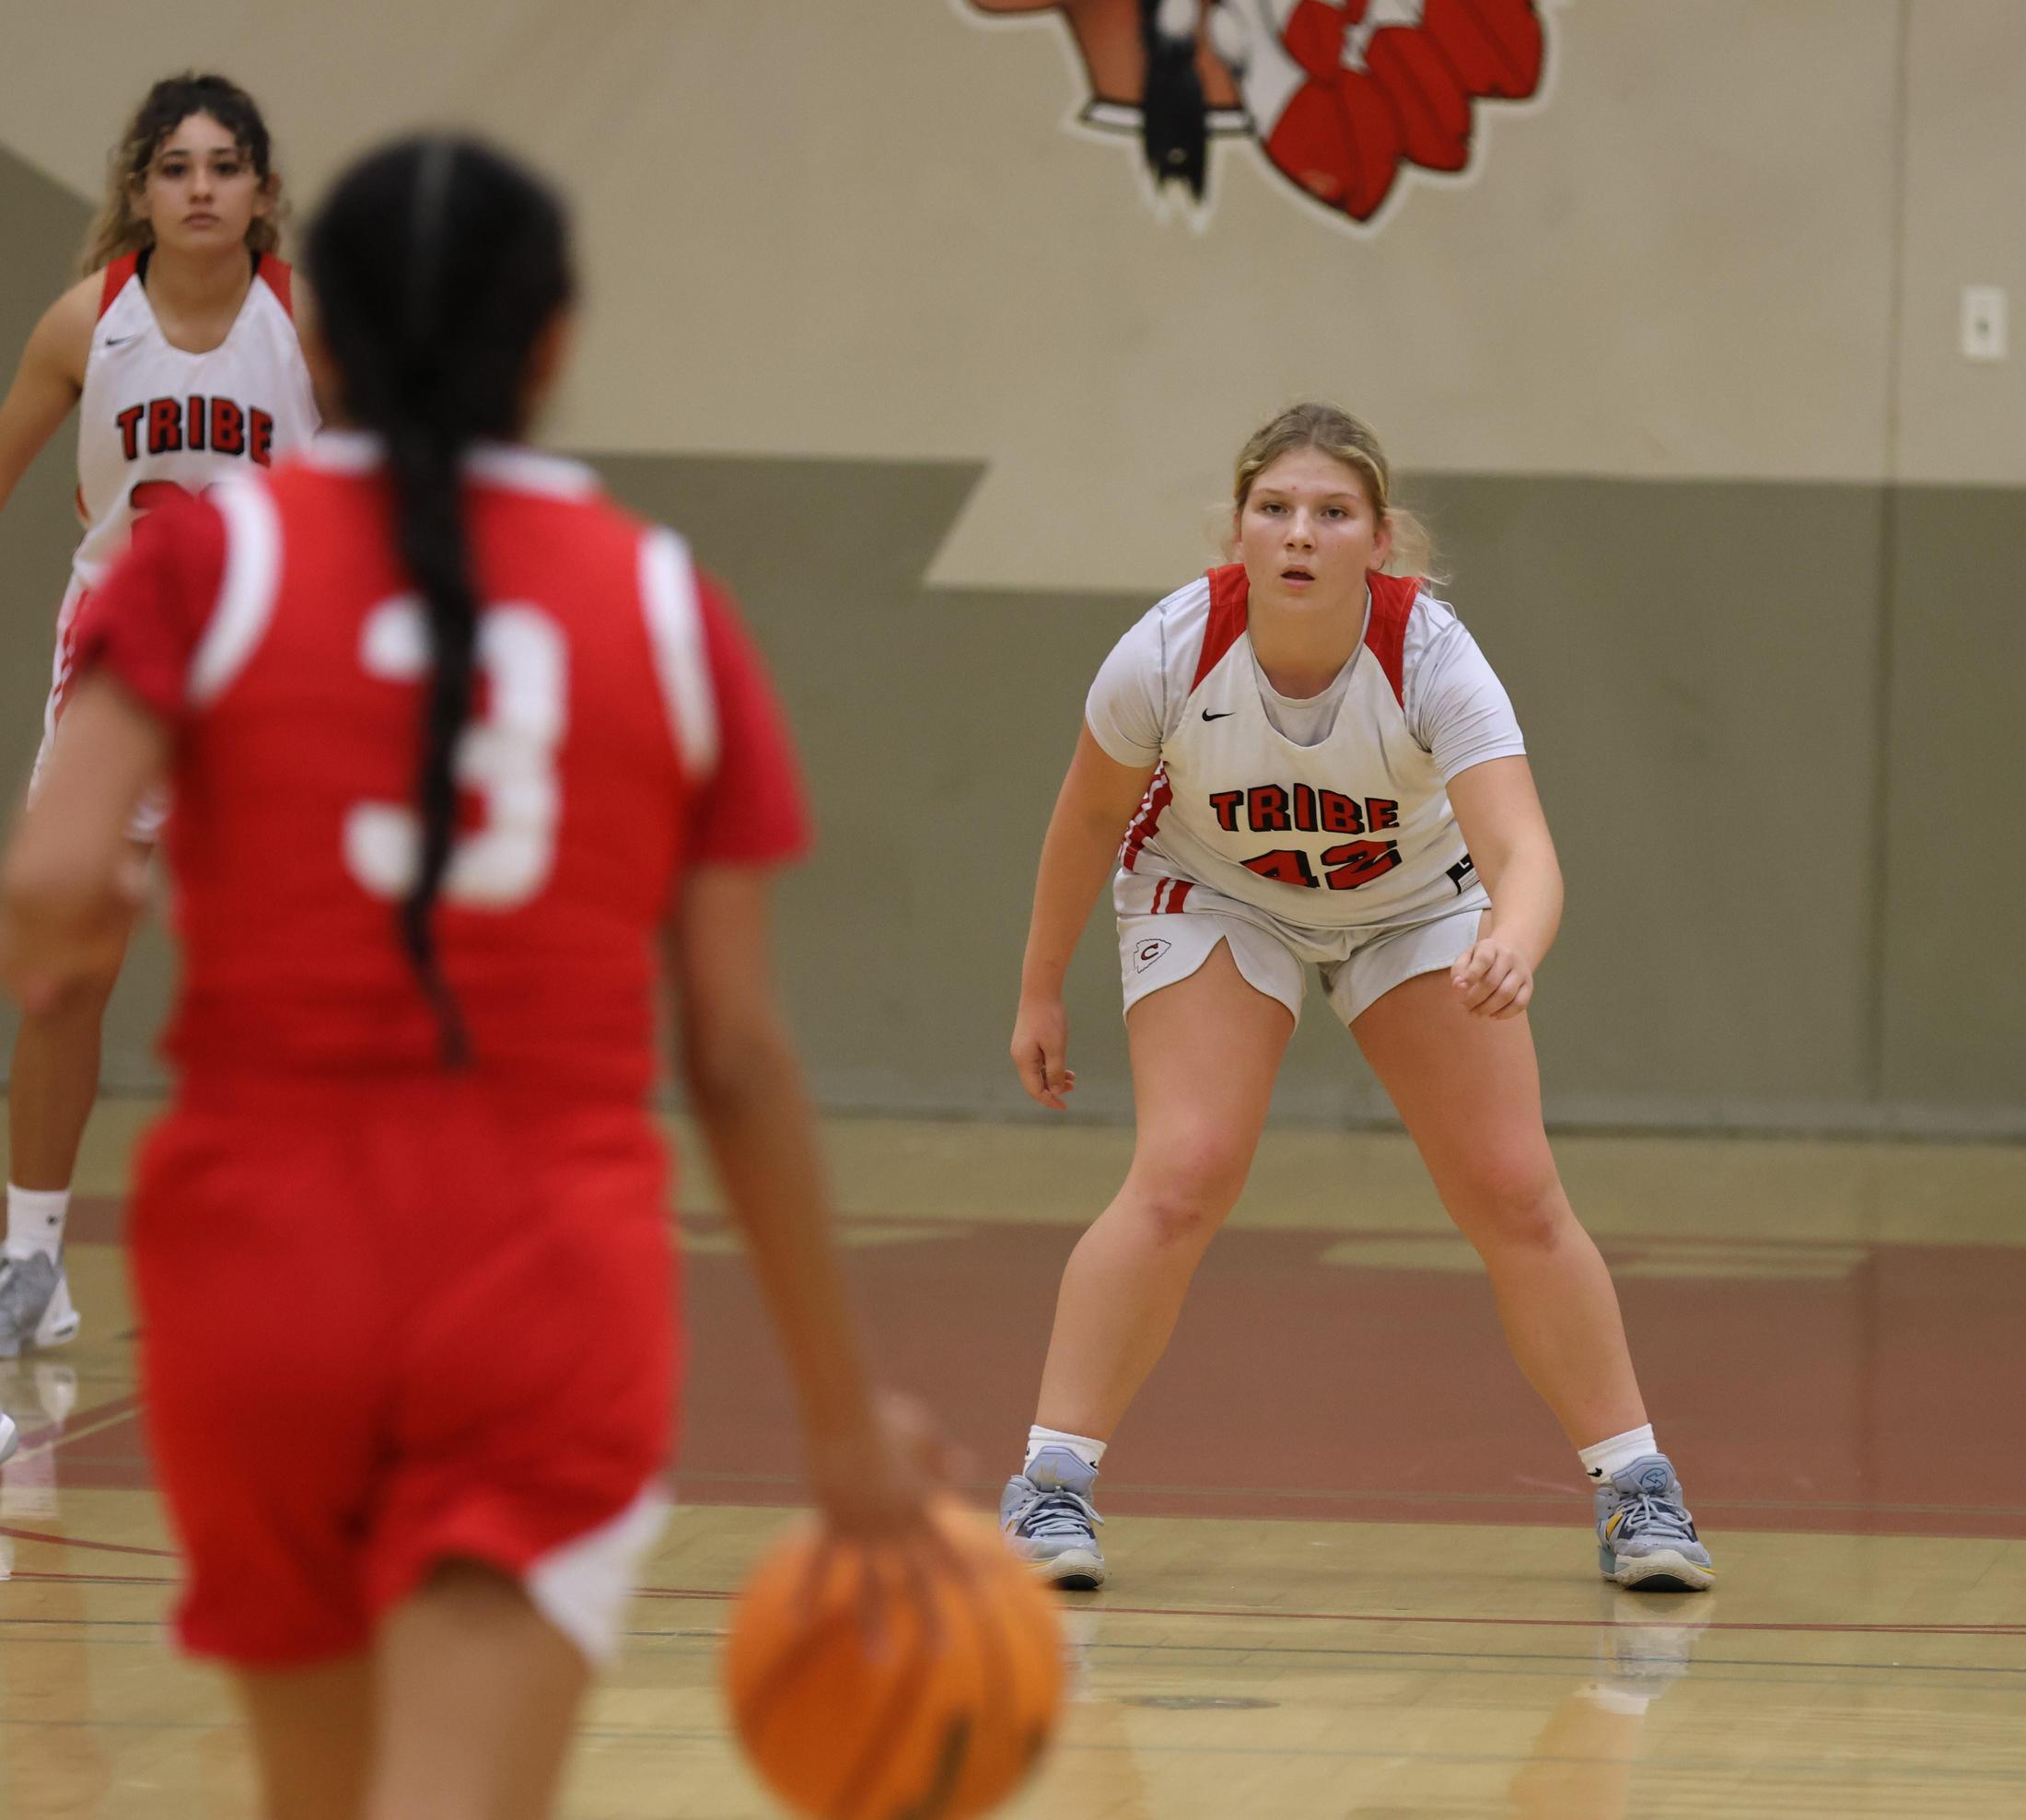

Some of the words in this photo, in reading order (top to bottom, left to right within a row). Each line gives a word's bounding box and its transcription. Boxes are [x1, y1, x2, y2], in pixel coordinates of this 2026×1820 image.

[116, 393, 274, 468] TRIBE
[343, 593, 571, 914] 3
[1209, 783, 1400, 834] TRIBE
[1240, 839, 1403, 890] 42
[1140, 942, 1159, 961] C
